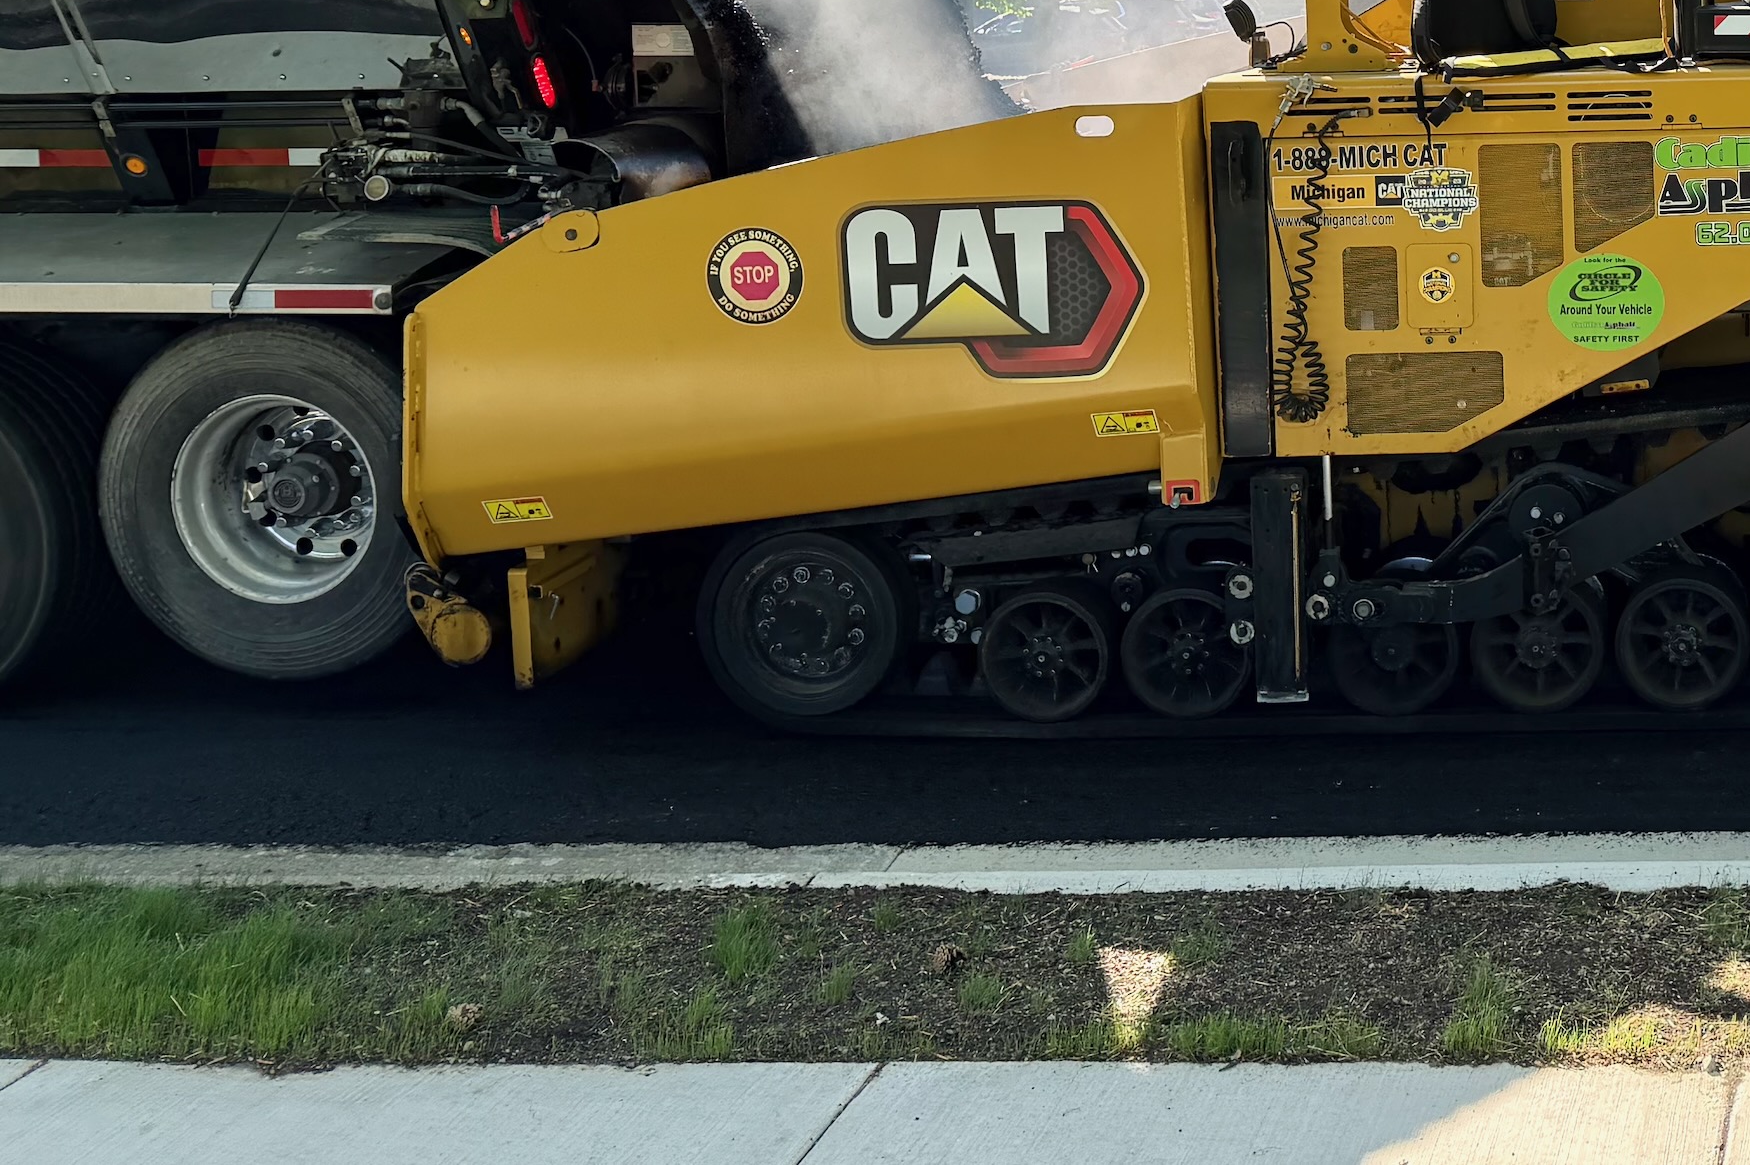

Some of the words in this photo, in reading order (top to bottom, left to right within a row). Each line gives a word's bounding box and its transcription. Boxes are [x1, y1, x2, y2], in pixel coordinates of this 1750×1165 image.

[1404, 144, 1446, 166] CAT
[1378, 183, 1404, 199] CAT
[1410, 188, 1470, 198] NATIONAL
[1405, 198, 1476, 208] CHAMPIONS
[728, 232, 747, 246] SEE
[712, 242, 729, 263] YOU
[749, 231, 798, 272] SOMETHING,
[710, 264, 718, 275] IF
[734, 266, 774, 284] STOP
[846, 206, 1065, 340] CAT
[718, 296, 733, 311] DO
[733, 294, 794, 321] SOMETHING
[1560, 304, 1592, 315] Around
[1595, 304, 1616, 314] Your
[1619, 304, 1652, 314] Vehicle
